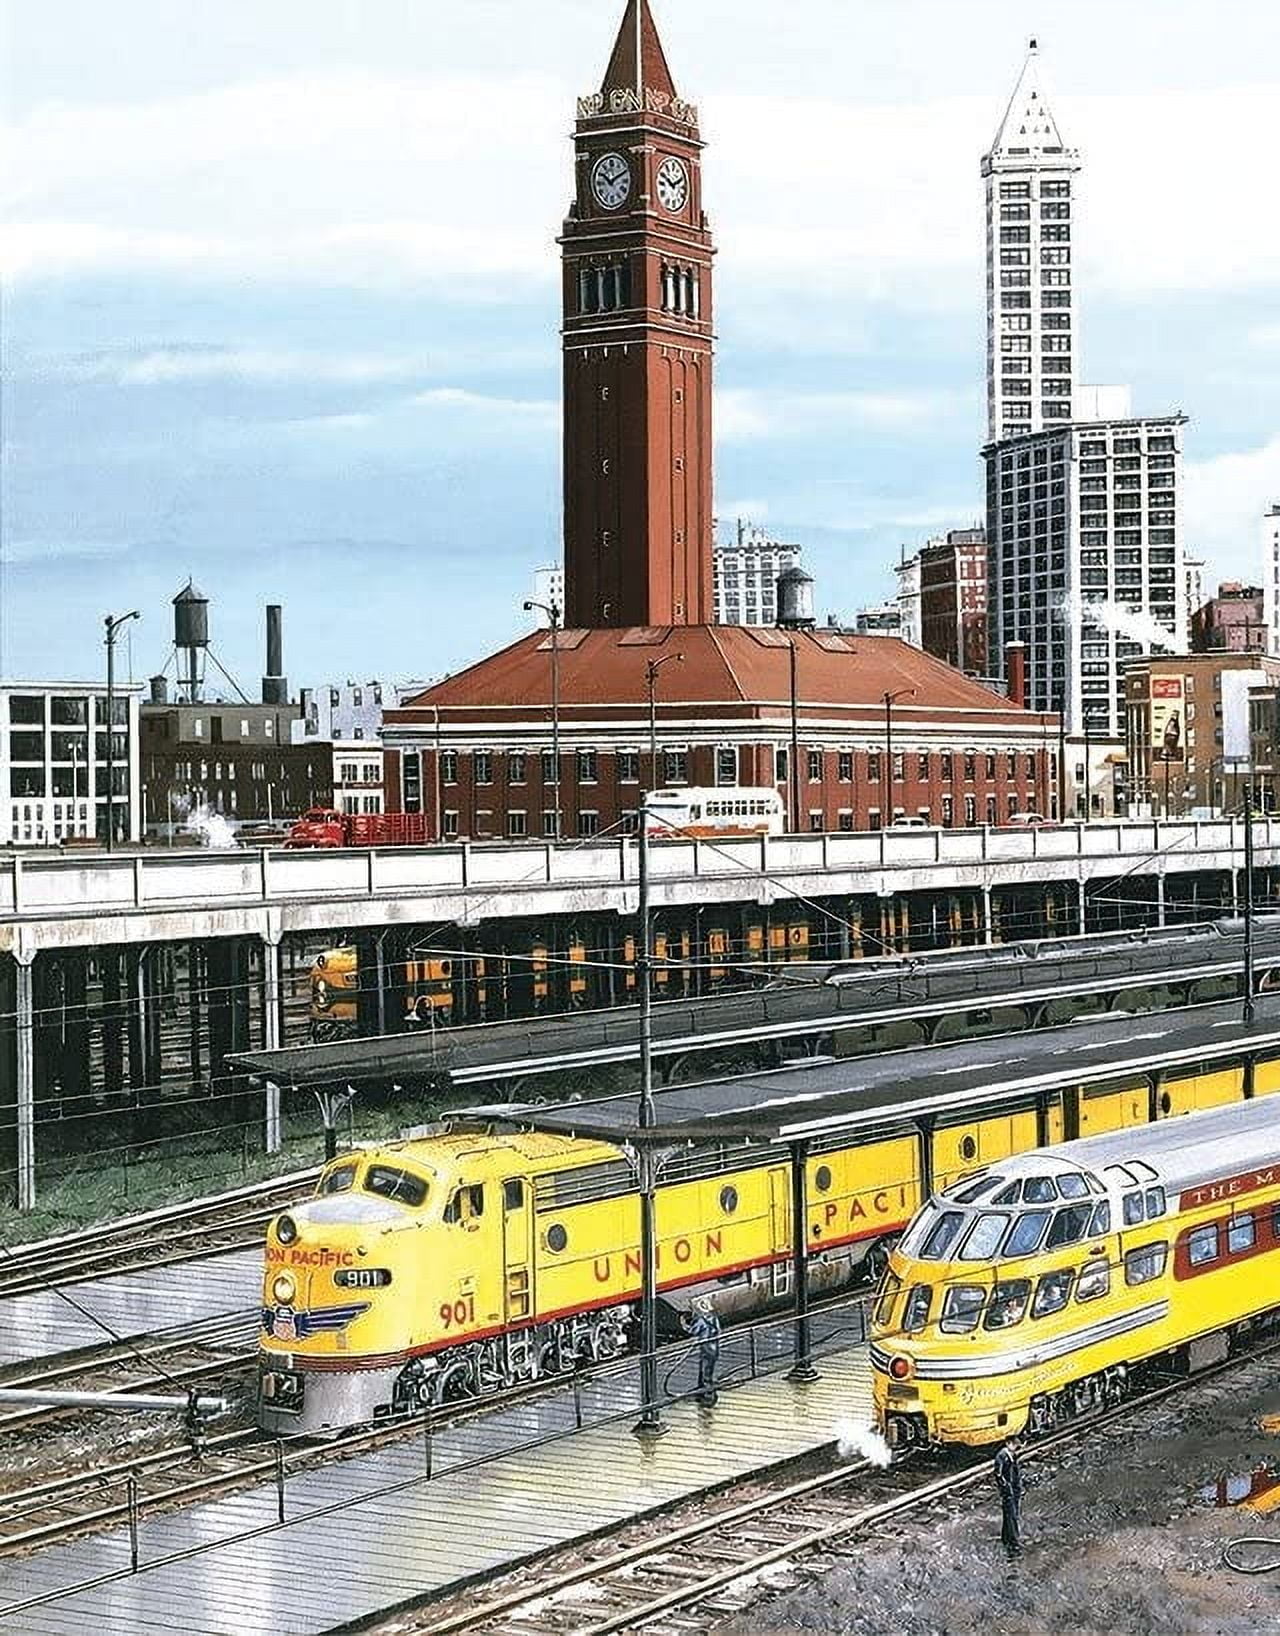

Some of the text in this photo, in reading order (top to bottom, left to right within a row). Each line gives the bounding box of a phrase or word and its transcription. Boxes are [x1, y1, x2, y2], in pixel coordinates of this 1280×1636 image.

[1193, 1181, 1242, 1204] THE
[291, 1251, 354, 1267] PACIFIC
[593, 1230, 723, 1282] UNION
[347, 1271, 378, 1287] 901
[440, 1297, 475, 1328] 901
